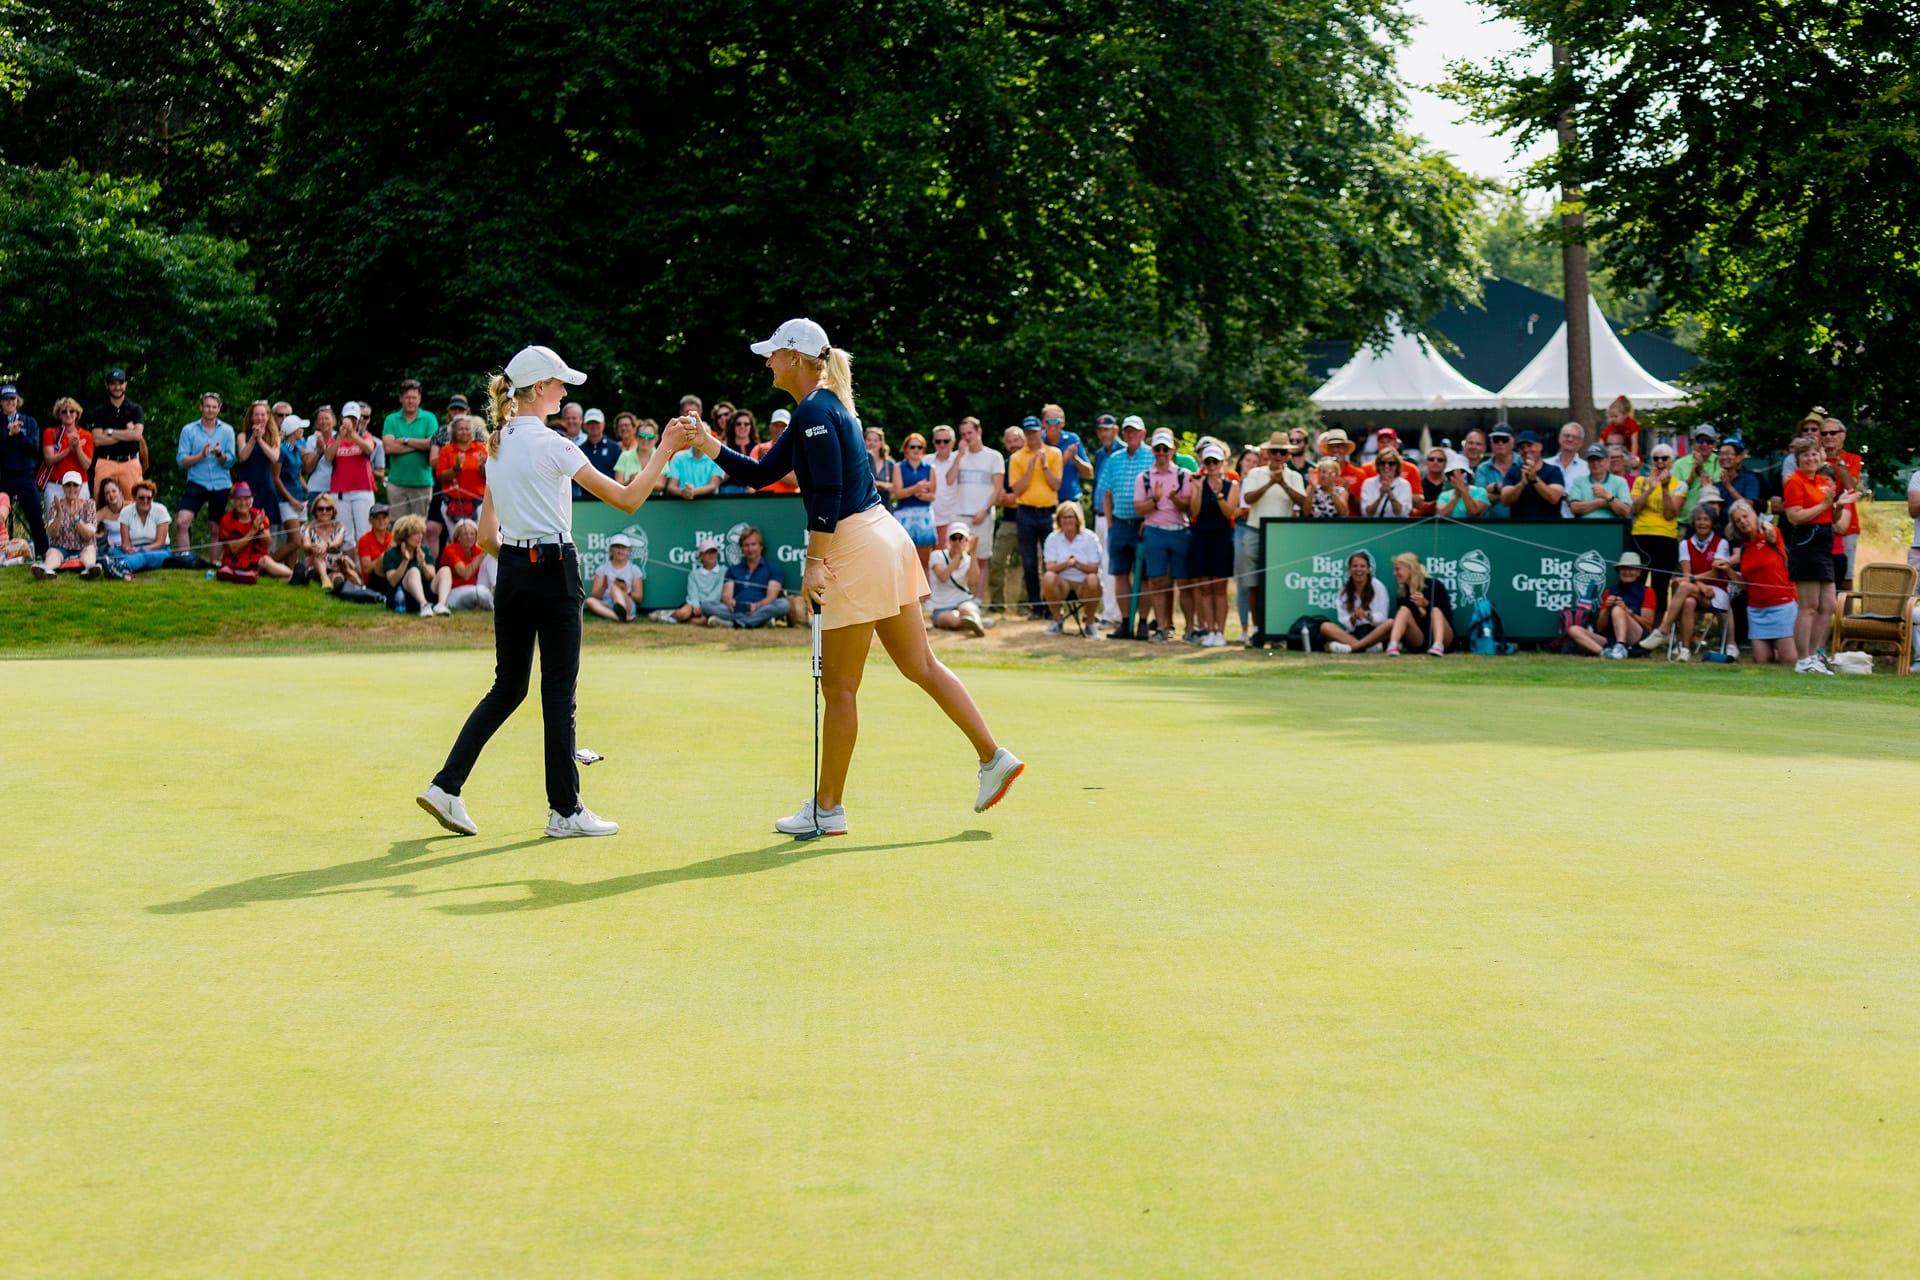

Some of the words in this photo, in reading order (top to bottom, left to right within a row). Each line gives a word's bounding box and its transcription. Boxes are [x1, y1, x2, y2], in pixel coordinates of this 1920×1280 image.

[777, 545, 808, 562] Gre
[1312, 556, 1343, 577] Big
[1426, 557, 1457, 578] Big
[1540, 557, 1573, 578] Big
[1285, 572, 1343, 589] Green
[1512, 574, 1573, 591] Green
[1536, 591, 1573, 611] Egg
